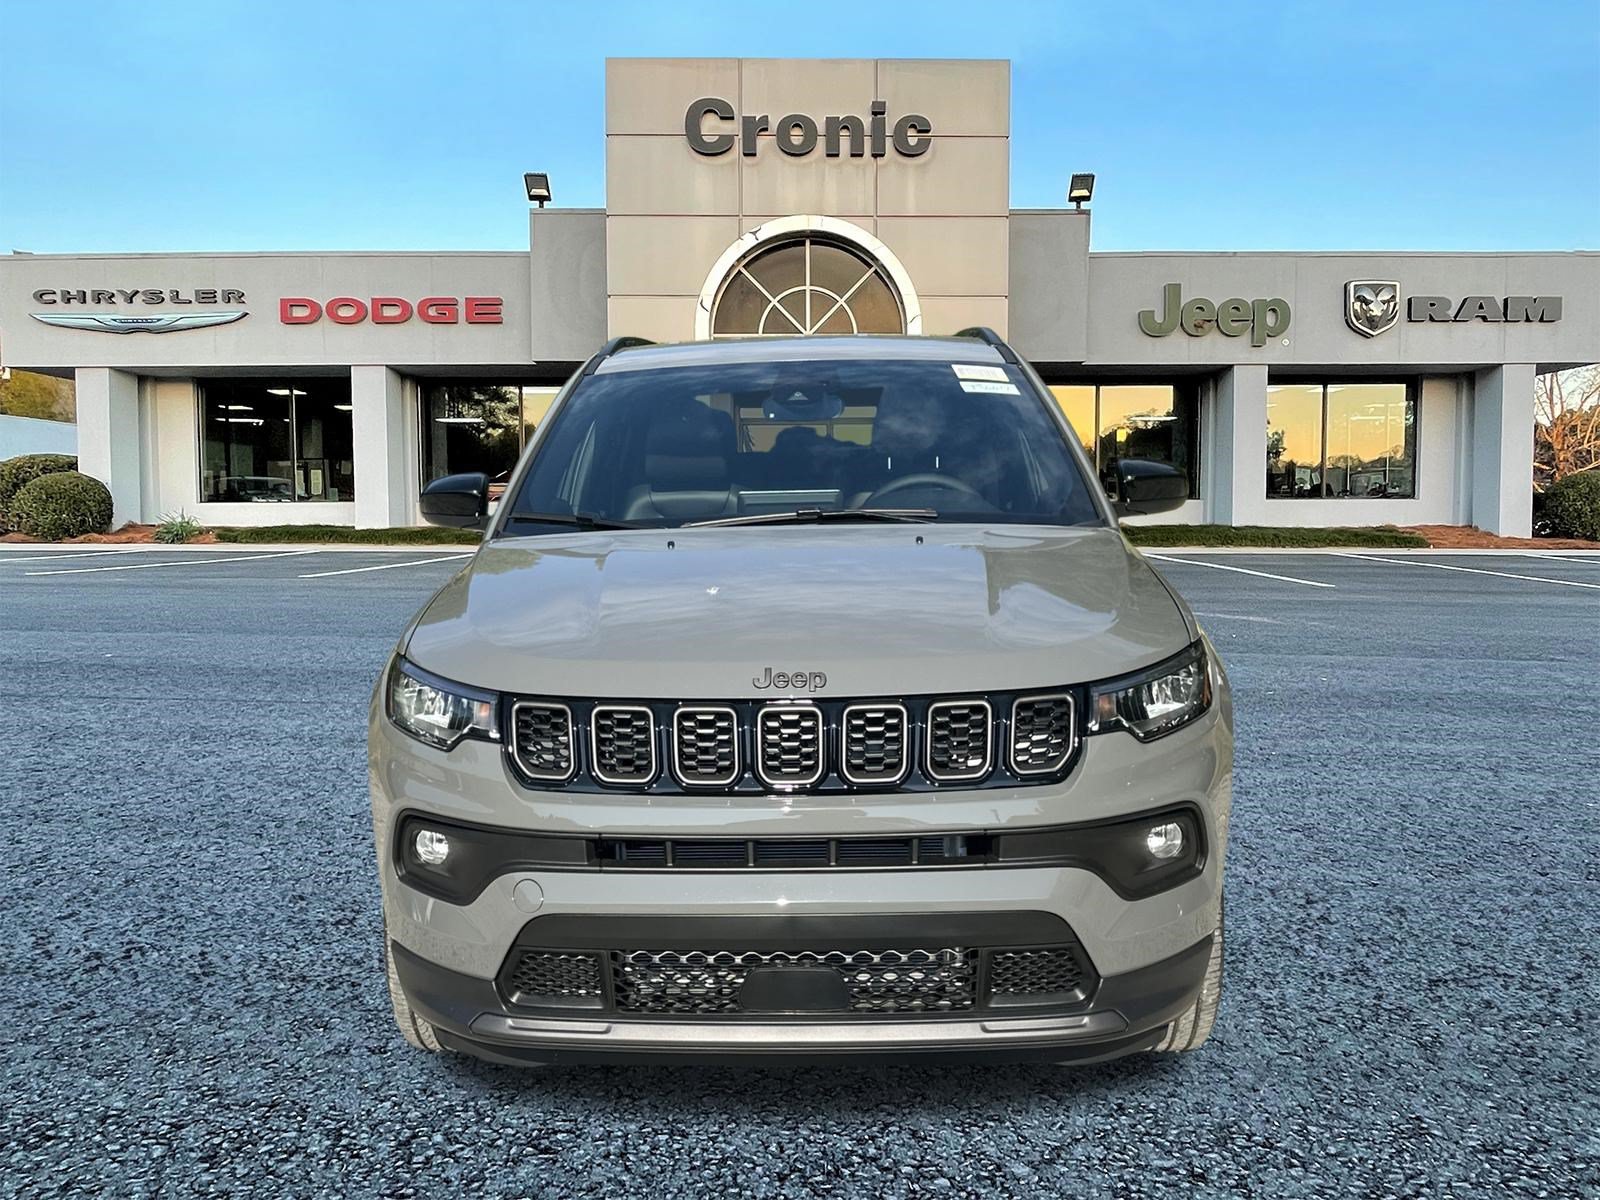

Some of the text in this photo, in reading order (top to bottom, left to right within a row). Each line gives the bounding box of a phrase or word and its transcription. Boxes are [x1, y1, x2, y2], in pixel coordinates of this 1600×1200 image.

[685, 97, 932, 157] Cronic
[32, 289, 246, 304] CHRYSLER
[1407, 296, 1562, 322] RAM
[279, 297, 503, 324] DODGE
[1138, 283, 1291, 347] Jeep
[752, 667, 827, 692] Jeep
